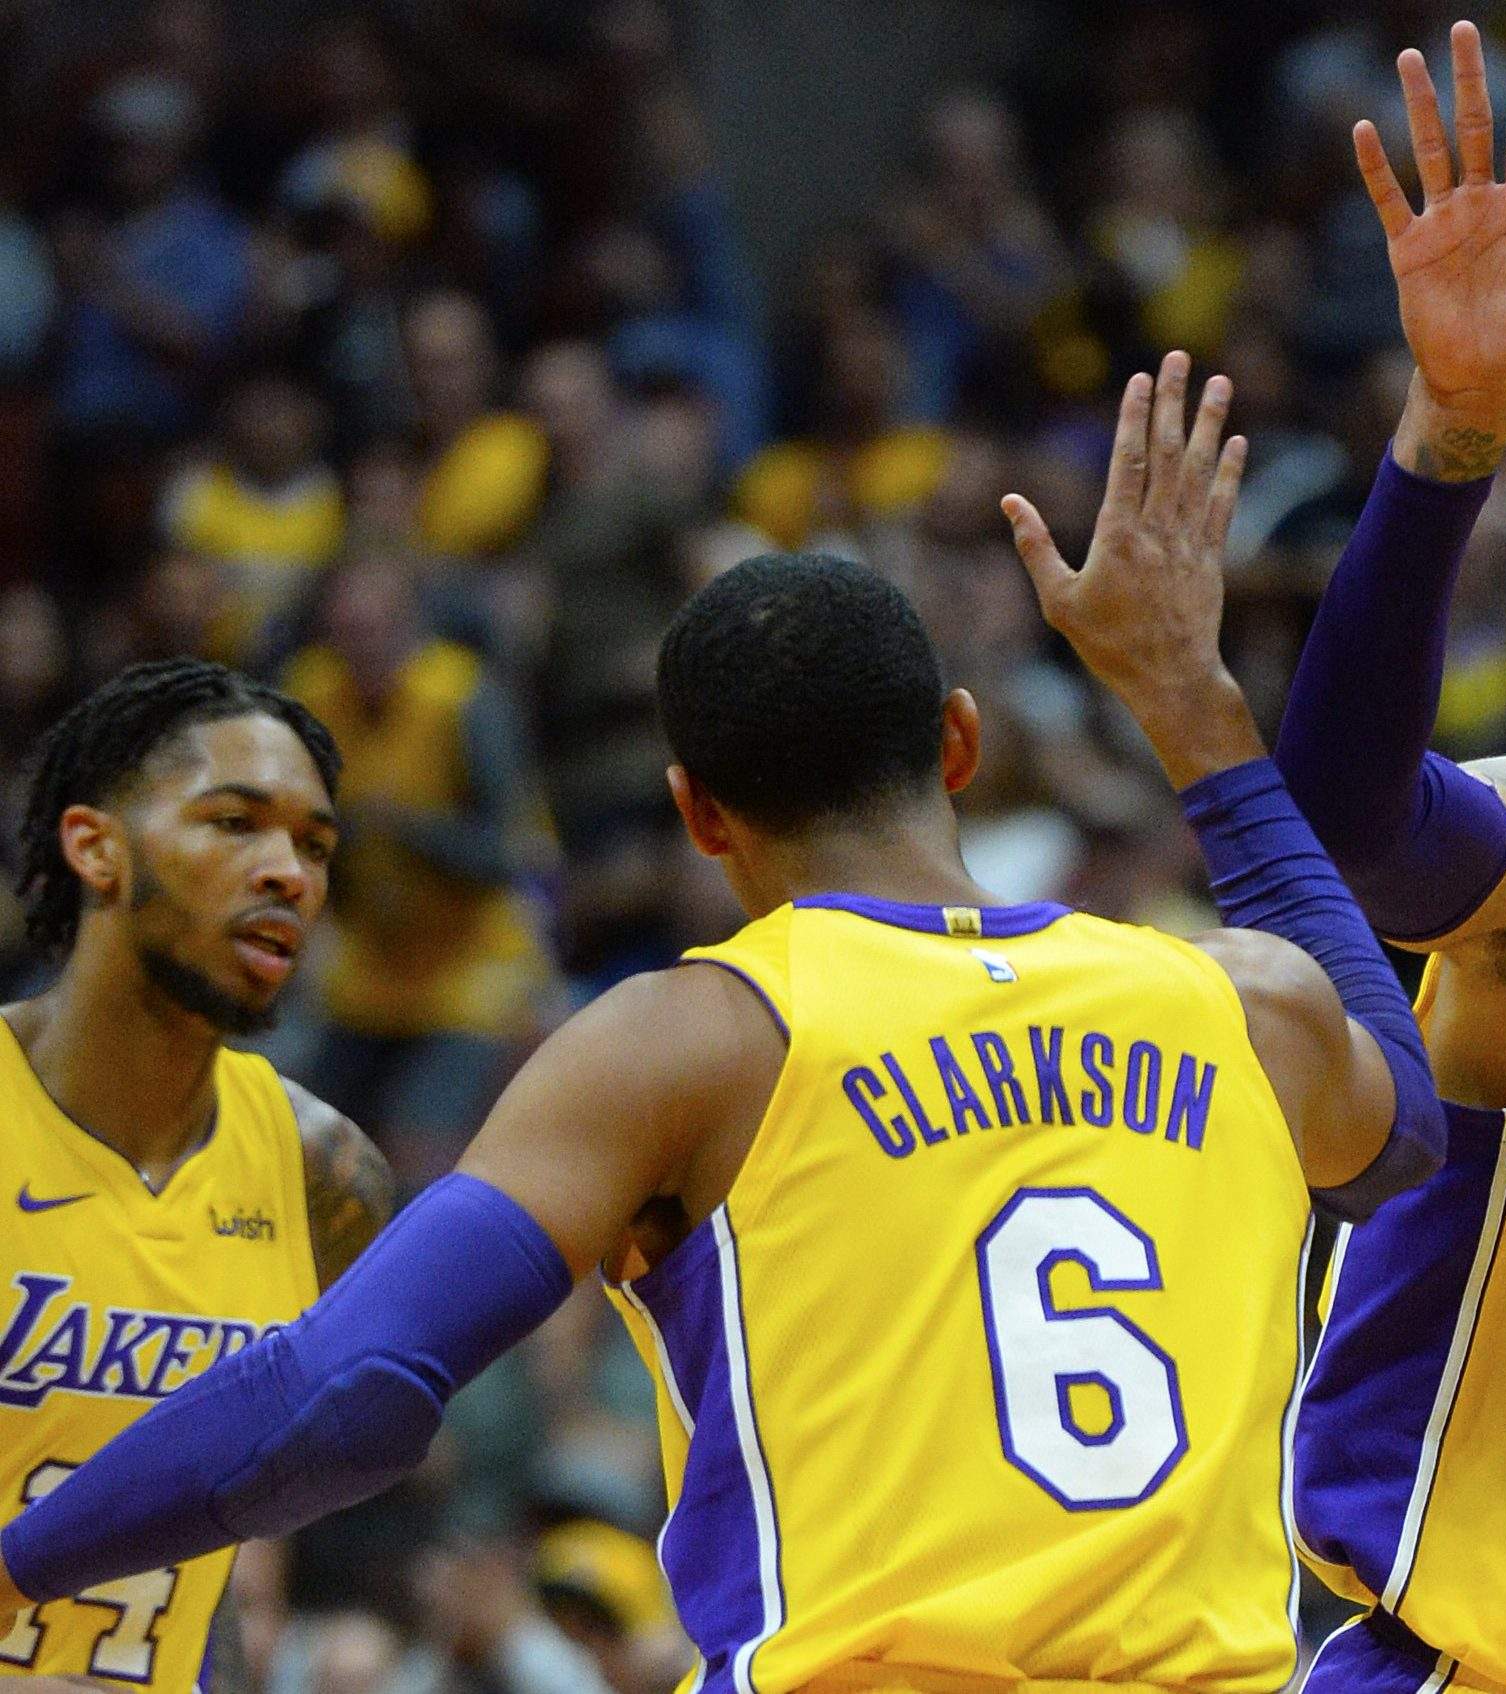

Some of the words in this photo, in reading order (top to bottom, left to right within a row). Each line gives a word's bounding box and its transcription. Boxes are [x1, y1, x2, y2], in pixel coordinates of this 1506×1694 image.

[841, 1025, 1218, 1160] CLARKSON
[0, 1272, 290, 1408] LAKE
[975, 1186, 1190, 1512] 6
